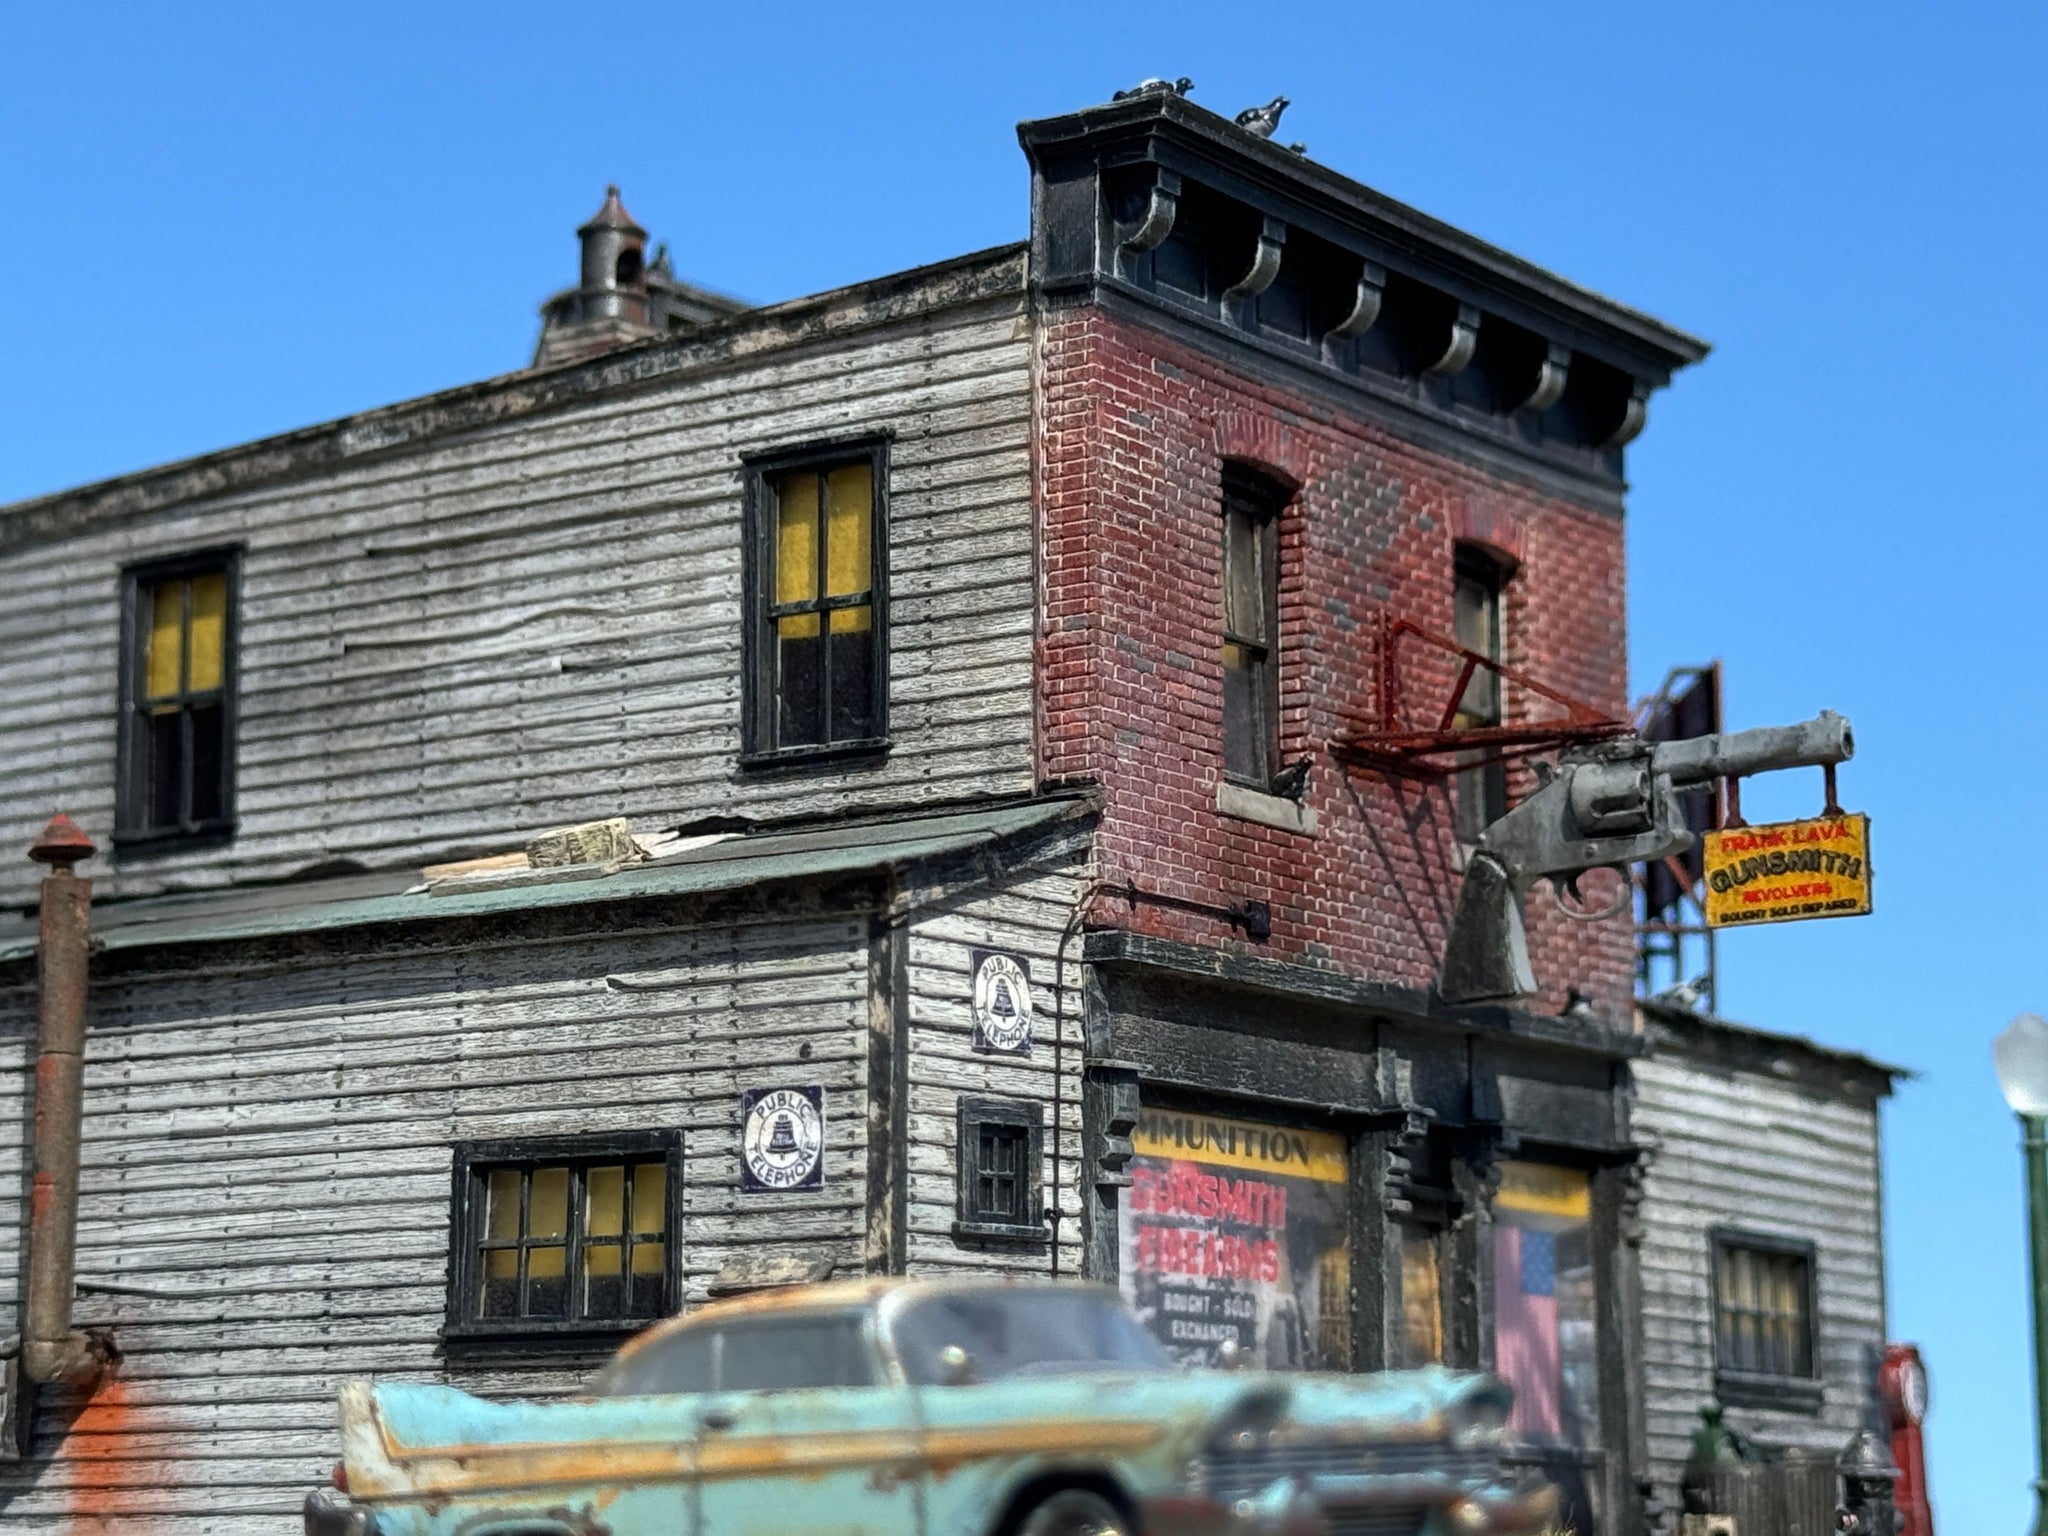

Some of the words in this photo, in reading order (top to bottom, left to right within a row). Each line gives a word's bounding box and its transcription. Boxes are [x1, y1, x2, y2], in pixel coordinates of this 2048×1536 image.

[1720, 831, 1787, 853] FRANK
[1793, 823, 1850, 844] LAVA
[1709, 848, 1862, 893] GUNSMITH
[1720, 908, 1767, 923] BOUGHT
[1769, 904, 1800, 918] SOLD
[1742, 882, 1833, 904] REVOLVERS
[982, 957, 1024, 985] PUBLIC
[976, 1001, 1030, 1047] TELEPHONE
[755, 1092, 812, 1119] PUBLIC
[1134, 1114, 1310, 1166] MMUNITION
[747, 1141, 818, 1185] TELEPHONE
[1130, 1166, 1287, 1228] GUNSMITH
[1137, 1226, 1279, 1282] FIREARMS
